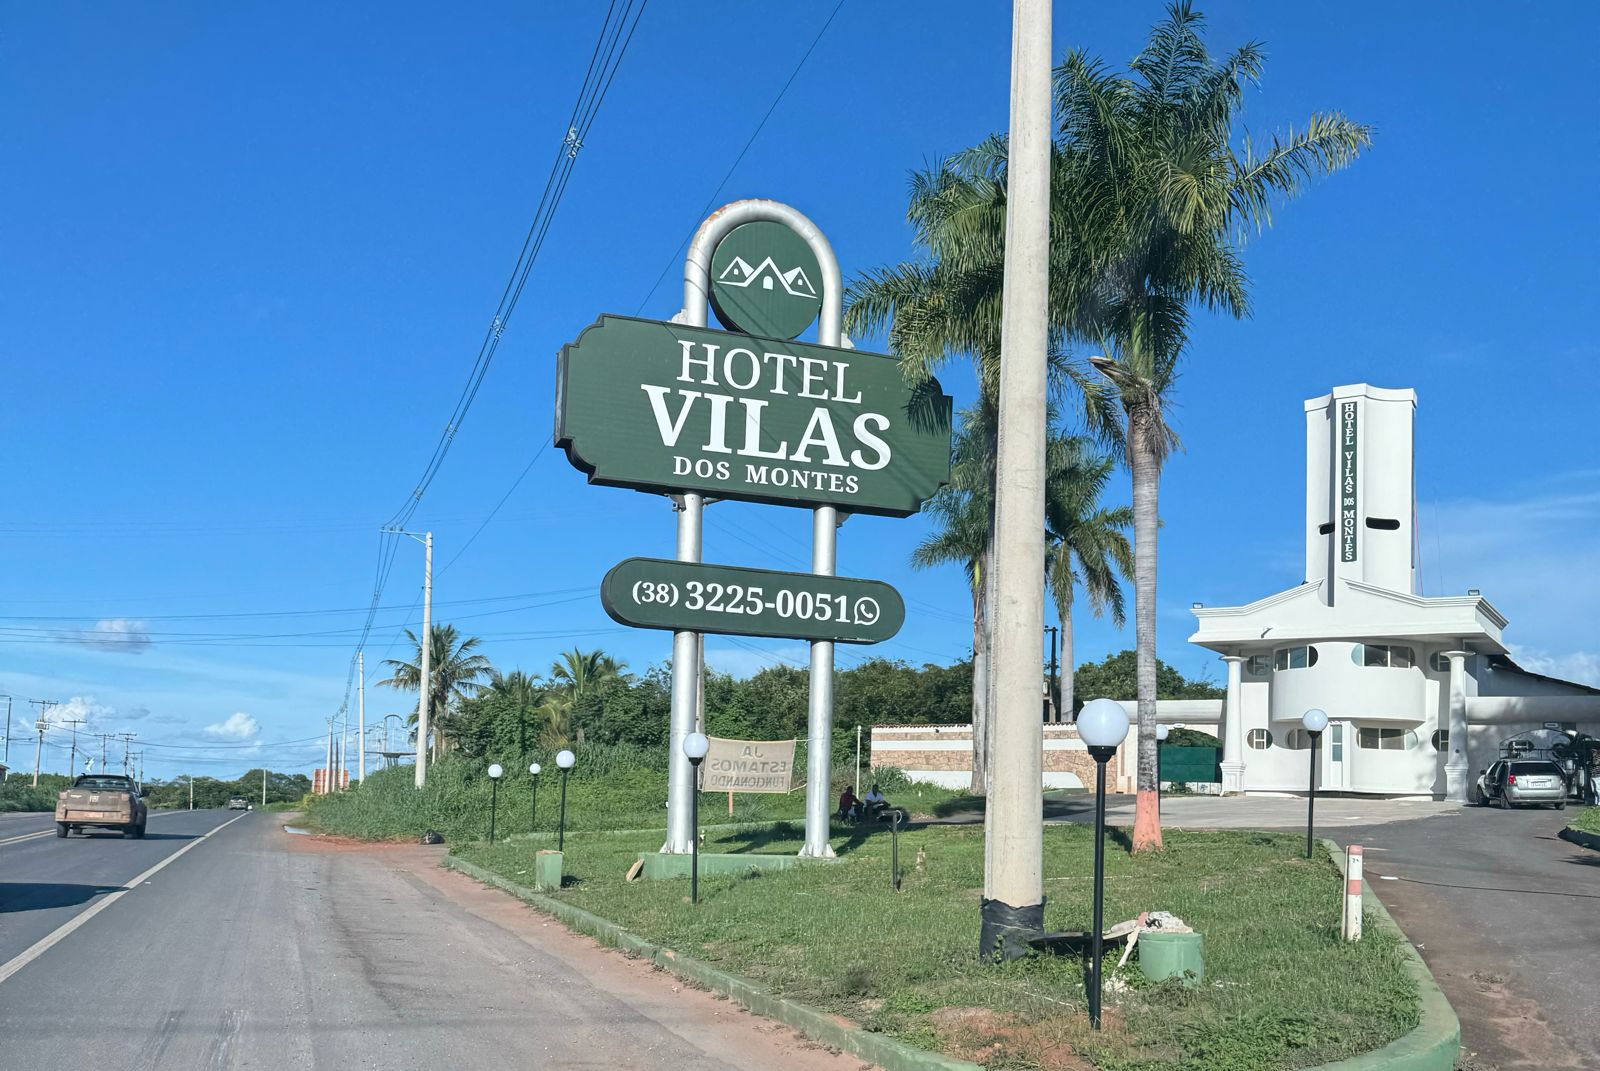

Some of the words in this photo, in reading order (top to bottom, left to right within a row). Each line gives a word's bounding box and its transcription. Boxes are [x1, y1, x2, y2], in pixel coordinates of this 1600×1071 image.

[677, 340, 862, 404] HOTEL
[641, 384, 892, 471] VILAS
[1344, 403, 1355, 445] HOTEL
[673, 456, 730, 480] DOS
[744, 464, 860, 494] MONTES
[1344, 452, 1355, 494] VILAS
[1343, 497, 1355, 506] DOS
[1343, 510, 1355, 561] MONTES
[632, 580, 680, 608] (38)
[685, 582, 851, 623] 3225-0051
